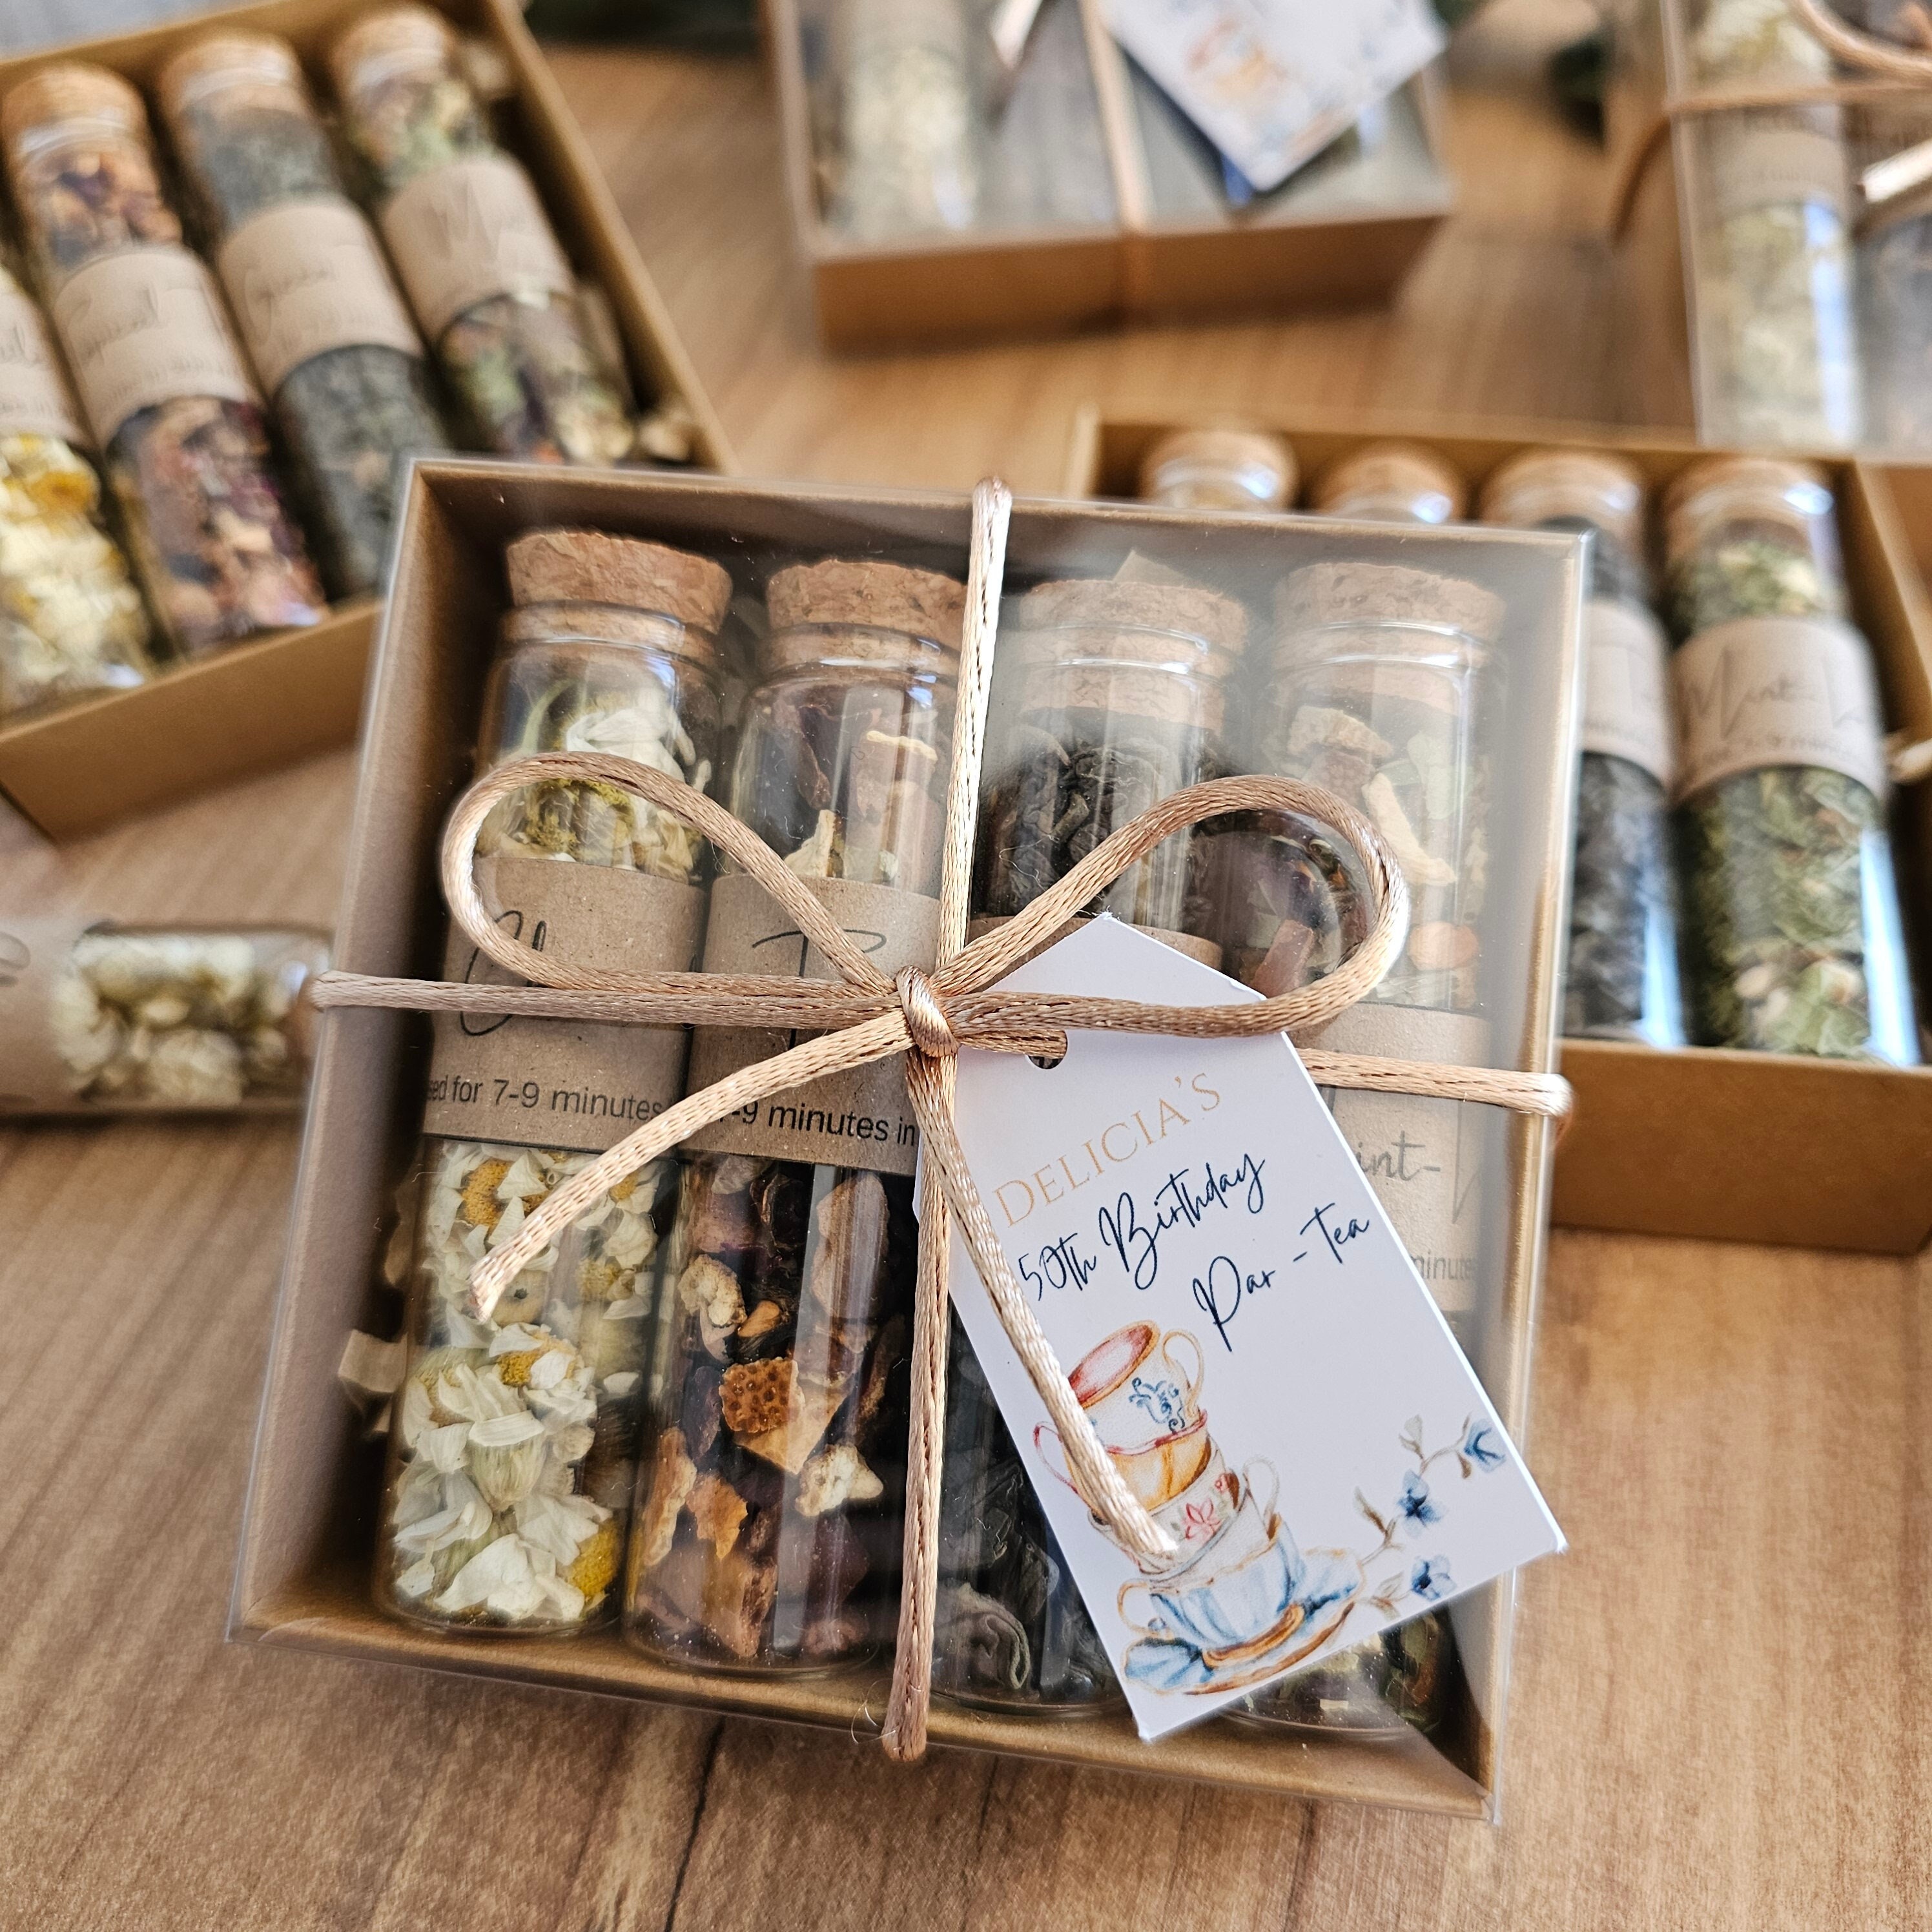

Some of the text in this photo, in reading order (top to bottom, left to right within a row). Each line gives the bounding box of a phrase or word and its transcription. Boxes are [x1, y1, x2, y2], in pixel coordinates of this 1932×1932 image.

[453, 1075, 483, 1104] for
[493, 1078, 540, 1109] 7-9
[550, 1087, 663, 1121] minutes
[768, 1102, 889, 1142] minutes
[897, 1115, 915, 1146] in
[992, 1073, 1220, 1228] DELICIA'S
[1018, 1153, 1266, 1301] 50th Birthday
